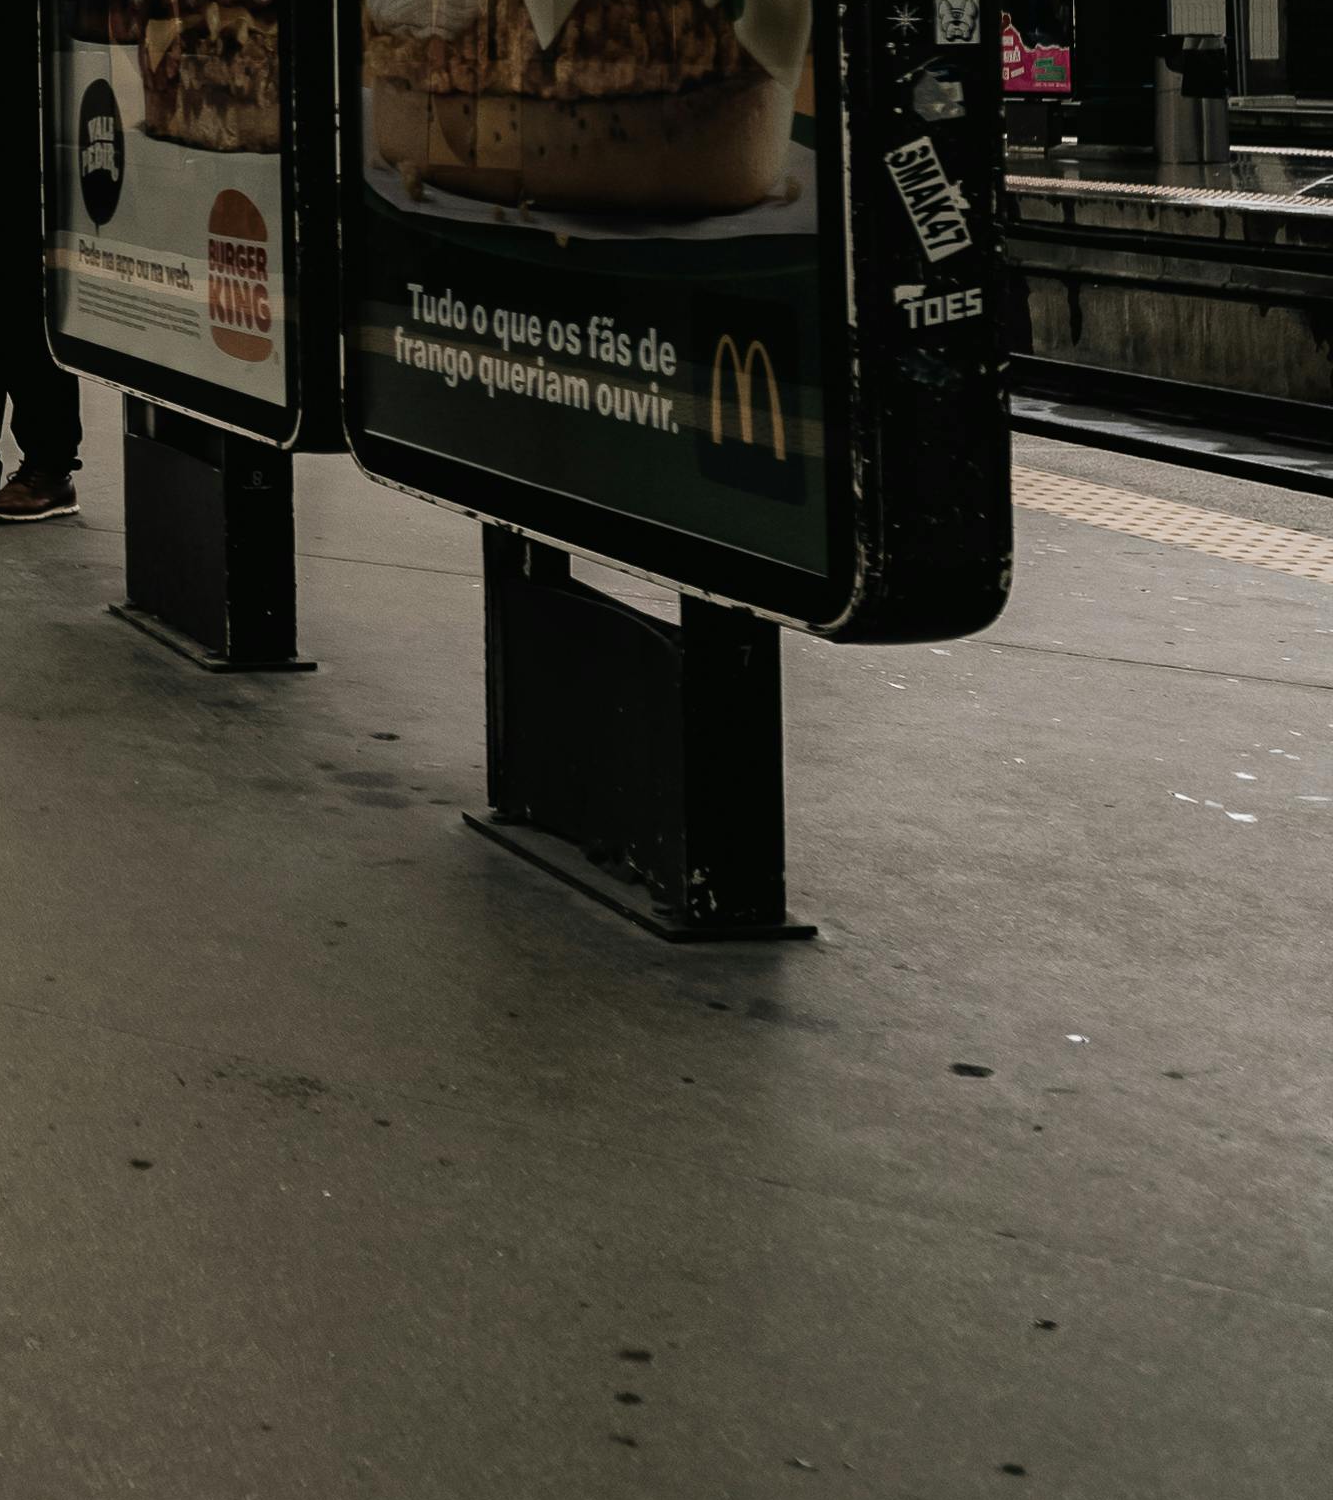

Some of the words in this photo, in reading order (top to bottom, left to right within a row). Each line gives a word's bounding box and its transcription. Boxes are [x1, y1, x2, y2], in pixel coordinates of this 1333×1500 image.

[890, 144, 969, 251] SMAK47
[79, 239, 101, 268] Pede
[102, 252, 114, 270] na
[116, 254, 135, 282] app
[136, 260, 150, 281] ou
[151, 262, 164, 284] na
[208, 238, 268, 282] BURGER
[208, 274, 272, 334] KING
[407, 283, 467, 331] Tudo
[472, 304, 487, 335] o
[493, 308, 542, 351] que
[547, 319, 582, 356] os
[588, 316, 632, 368] fãs
[638, 328, 677, 377] de
[903, 287, 983, 329] TOES
[394, 326, 473, 388] frango
[478, 353, 590, 412] queriam
[596, 381, 679, 435] ouvir.
